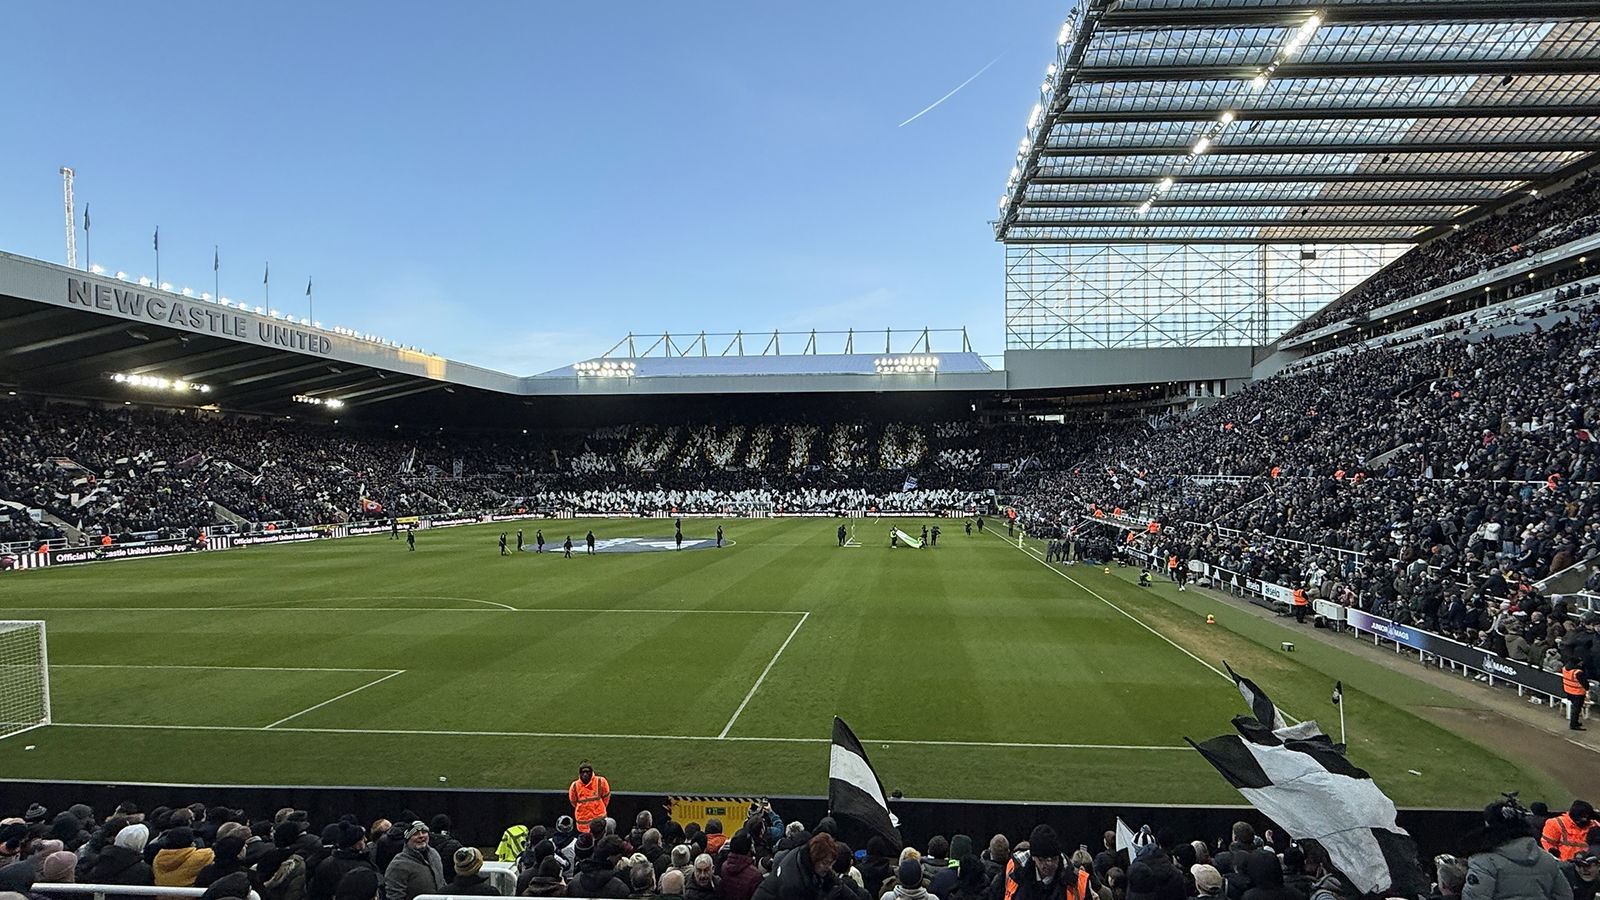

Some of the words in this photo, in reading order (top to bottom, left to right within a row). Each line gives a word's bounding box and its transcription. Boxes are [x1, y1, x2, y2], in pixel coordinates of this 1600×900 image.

[68, 278, 248, 338] NEWCASTLE
[258, 322, 332, 354] UNITED
[254, 535, 278, 543] Newcastle
[279, 533, 294, 541] United
[56, 553, 86, 562] Official
[127, 546, 149, 556] United
[151, 545, 173, 554] Mobile
[173, 544, 187, 552] App
[1394, 630, 1409, 640] MAGS
